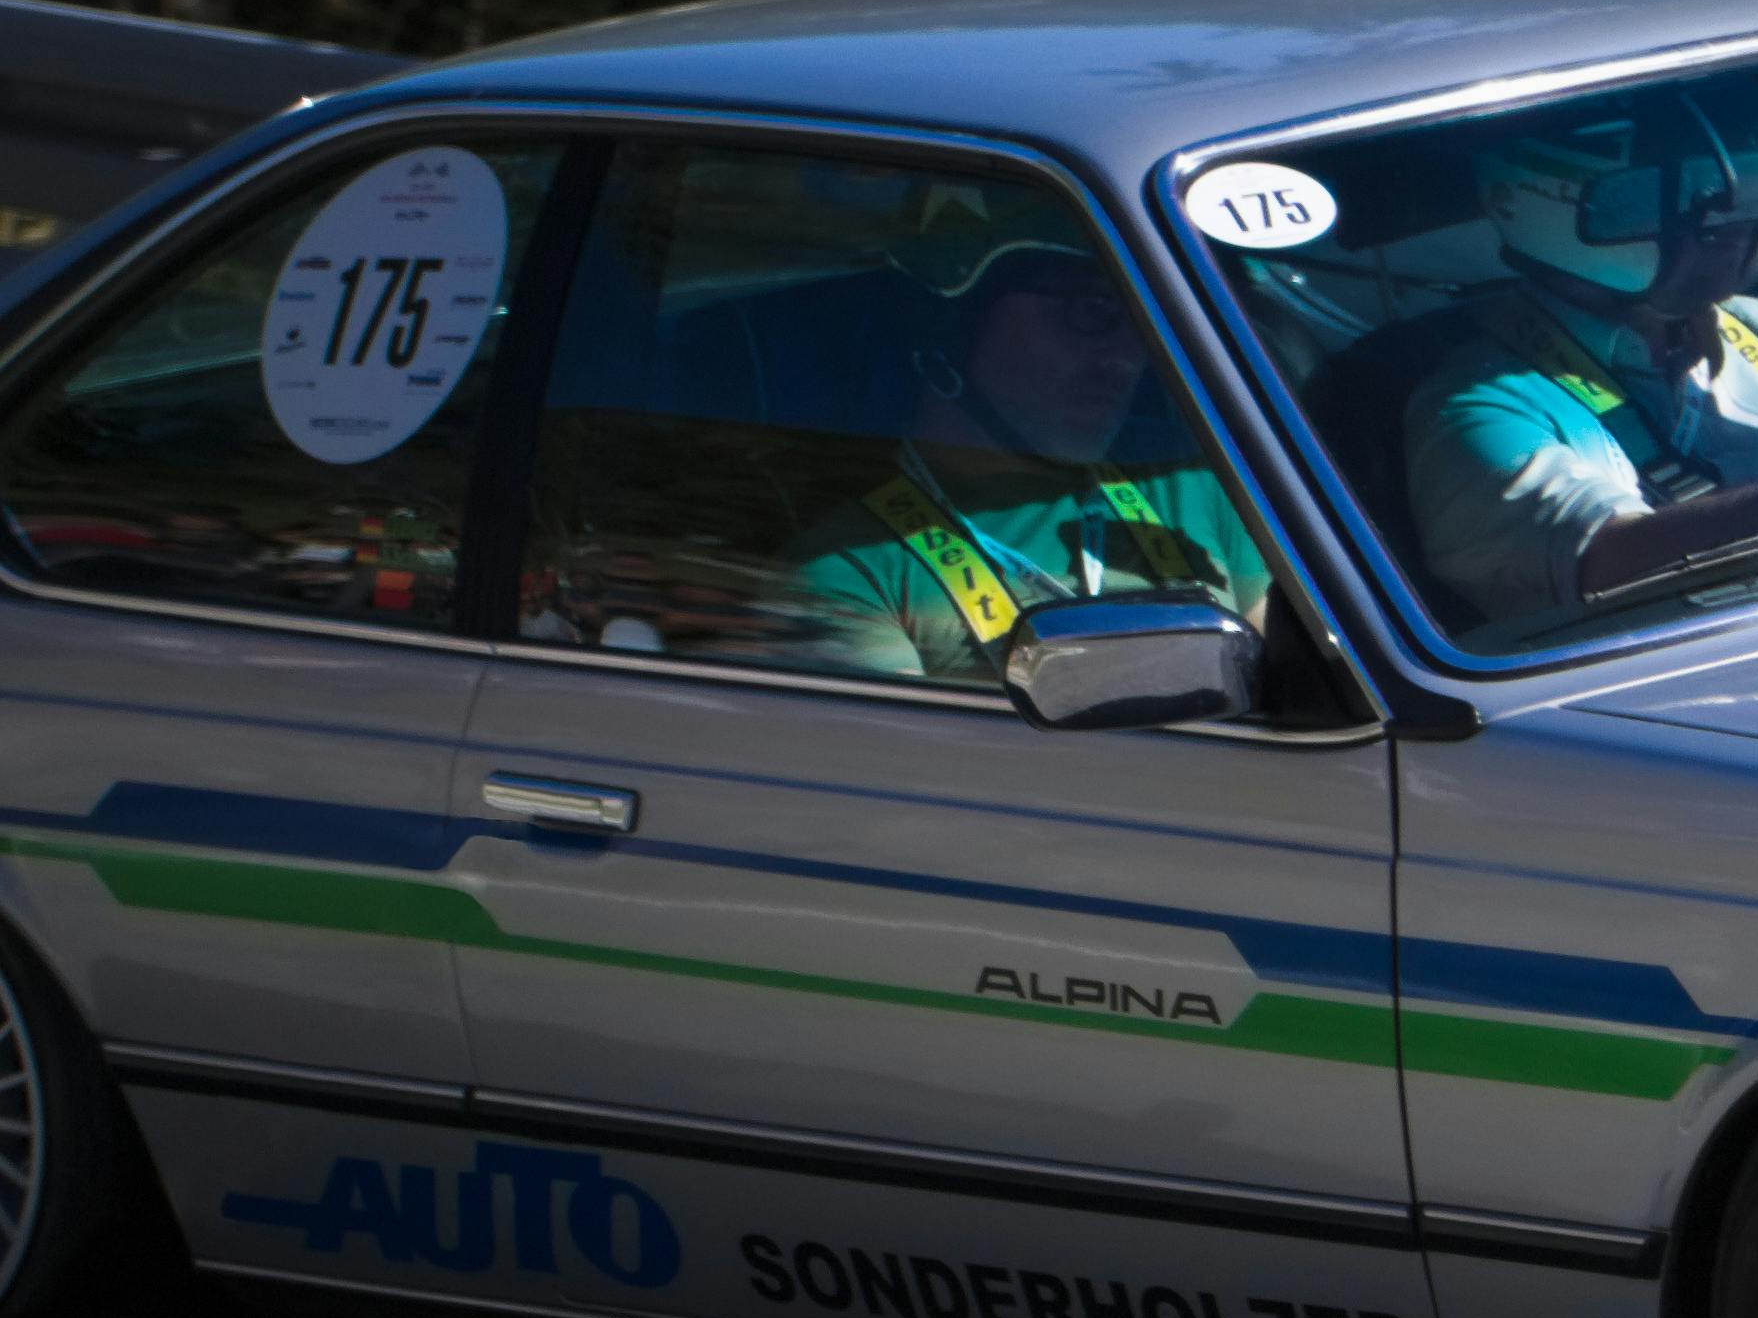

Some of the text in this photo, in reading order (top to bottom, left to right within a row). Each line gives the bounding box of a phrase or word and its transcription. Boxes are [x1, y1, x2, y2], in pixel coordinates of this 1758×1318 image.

[1219, 188, 1312, 232] 175
[323, 258, 444, 368] 175
[974, 965, 1222, 1025] ALPINA
[304, 1141, 682, 1288] AUTO
